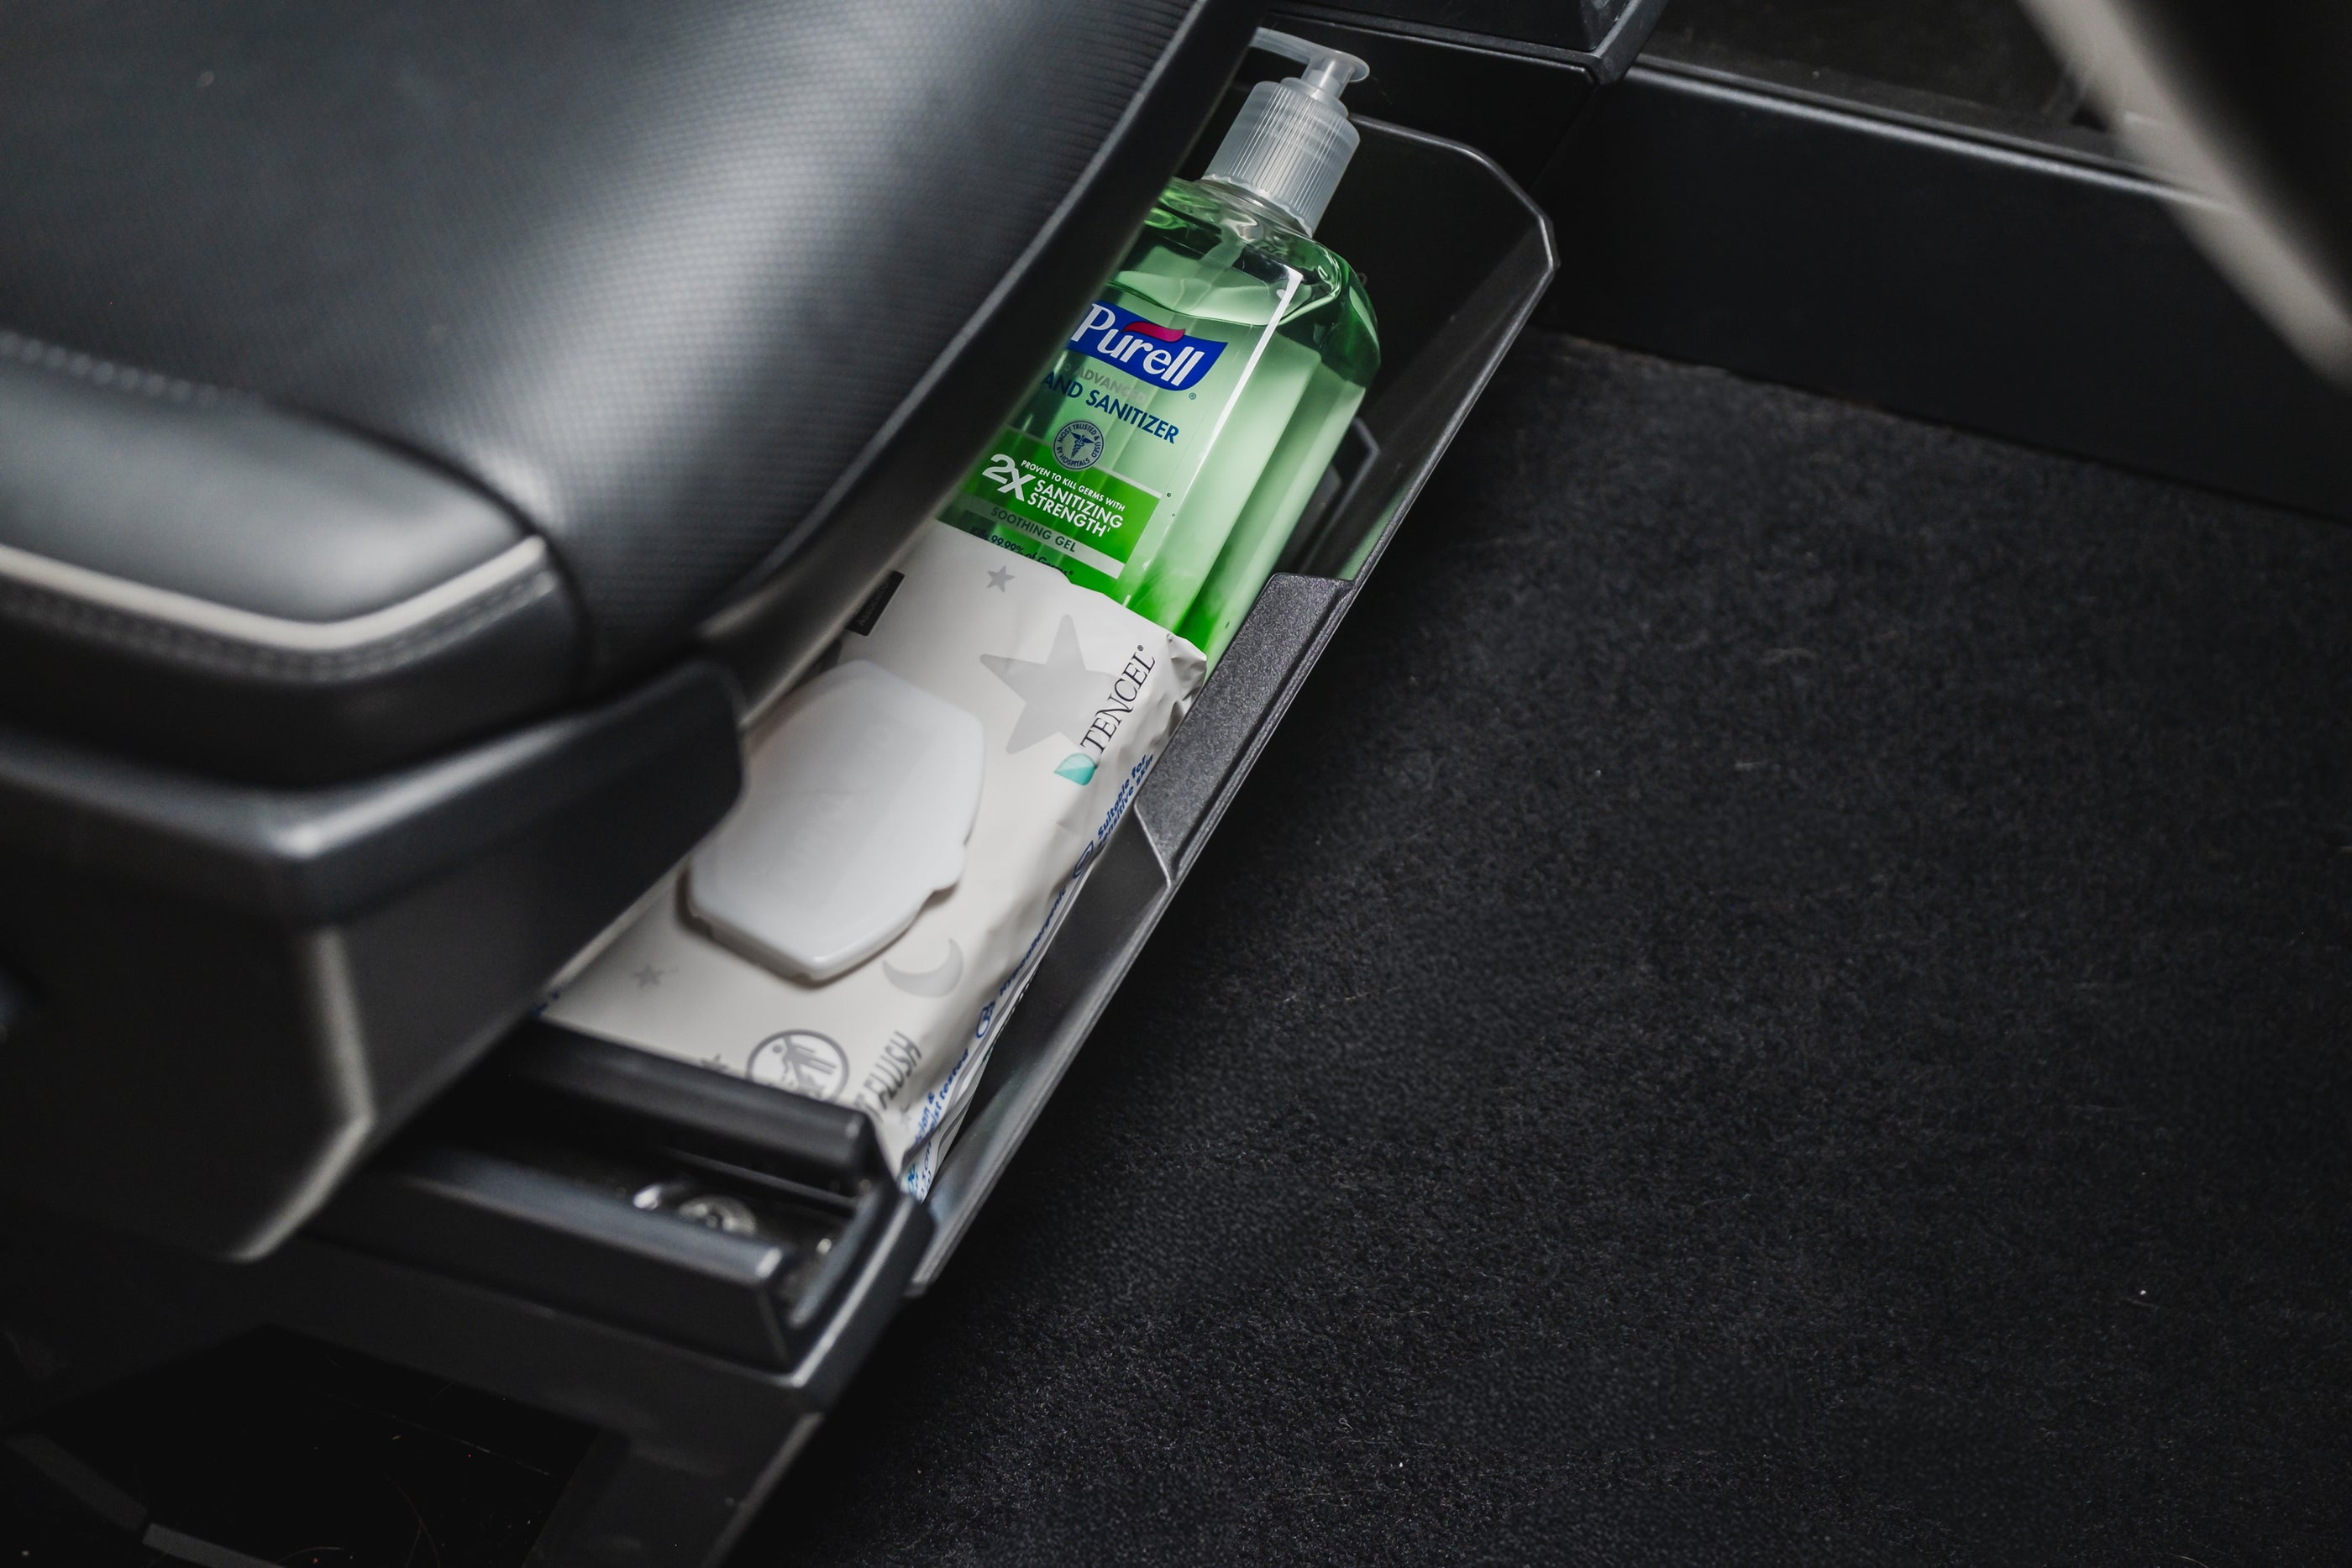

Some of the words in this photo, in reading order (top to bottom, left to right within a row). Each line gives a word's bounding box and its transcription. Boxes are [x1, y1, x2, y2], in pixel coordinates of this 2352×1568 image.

[1070, 303, 1205, 386] Purell
[1041, 370, 1084, 398] AND
[1085, 390, 1179, 444] SANITIZER
[1074, 368, 1147, 403] ADVANCED
[1058, 427, 1071, 443] MOST
[1073, 423, 1097, 436] TRUSTED
[1091, 442, 1101, 458] USED
[1059, 458, 1090, 467] HOSPITALS
[982, 454, 1036, 501] 2X
[1021, 460, 1051, 477] PROVEN
[1051, 472, 1062, 482] TO
[1062, 479, 1077, 490] KILL
[1078, 485, 1105, 501] GERMS
[1105, 497, 1126, 511] WITH
[1034, 480, 1124, 528] SANITIZING
[990, 506, 1051, 540] SOOTHING
[1055, 536, 1076, 553] GEL
[1137, 754, 1153, 786] skin
[1098, 779, 1130, 840] Suitable
[1131, 754, 1146, 779] for
[862, 1030, 922, 1111] FLUSH
